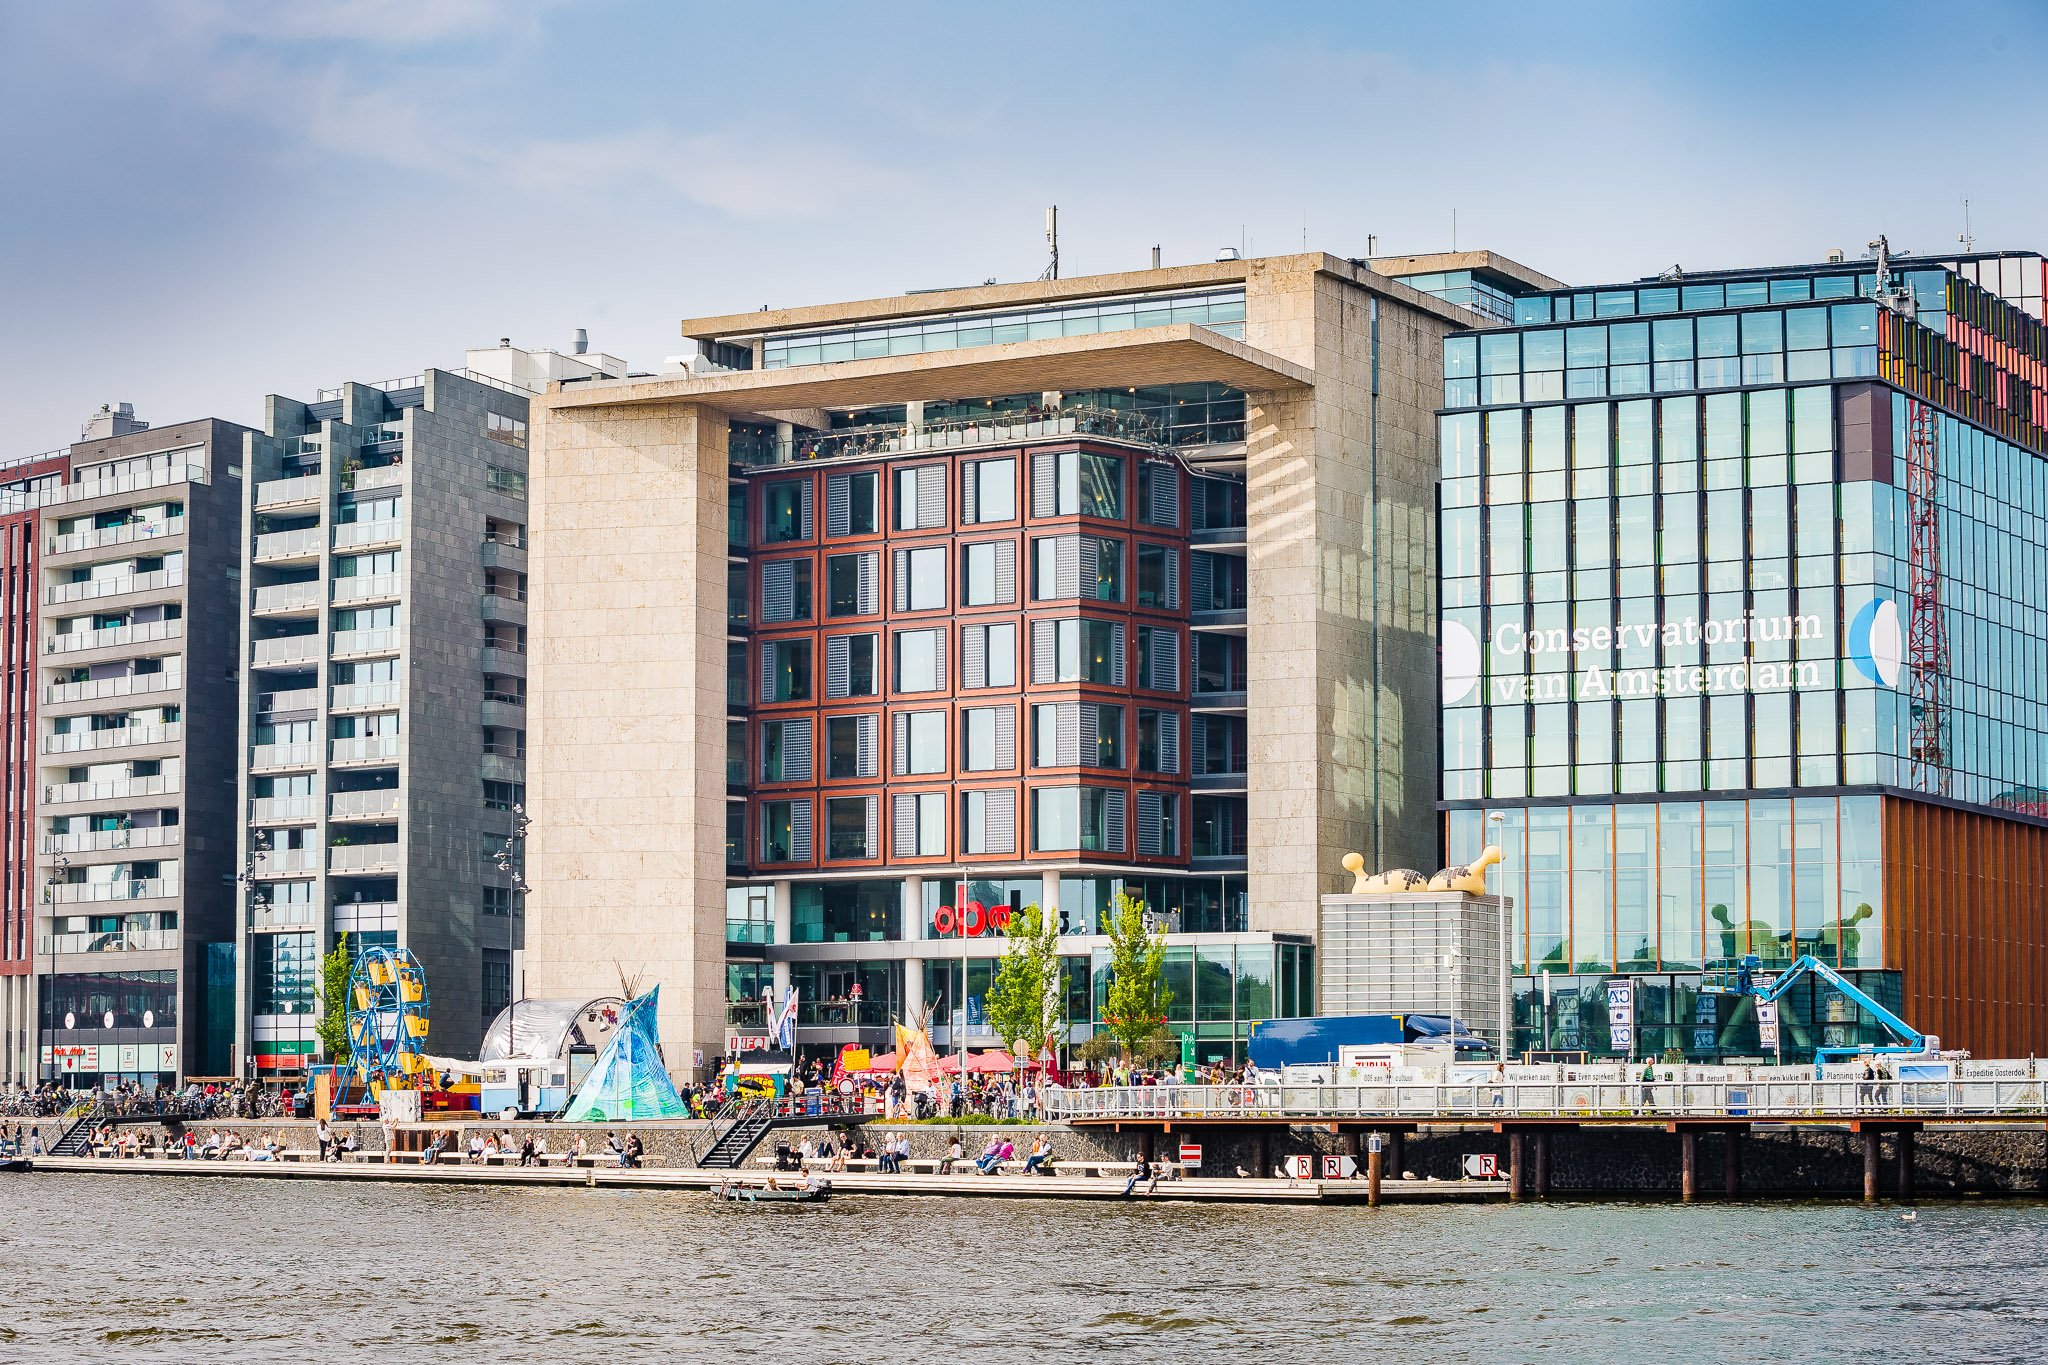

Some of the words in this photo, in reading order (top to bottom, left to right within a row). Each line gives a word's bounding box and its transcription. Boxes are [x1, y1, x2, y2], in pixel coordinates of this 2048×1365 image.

[1495, 609, 1823, 655] Conservatorium
[1495, 672, 1568, 704] van
[1580, 656, 1820, 699] Amsterdam
[732, 1038, 764, 1050] INFO
[1508, 1073, 1518, 1082] Wij
[1519, 1073, 1539, 1081] werken
[1578, 1072, 1591, 1081] Even
[1826, 1072, 1854, 1080] Planning
[1966, 1069, 1993, 1080] Expeditie
[1994, 1068, 2026, 1077] Oosterdok
